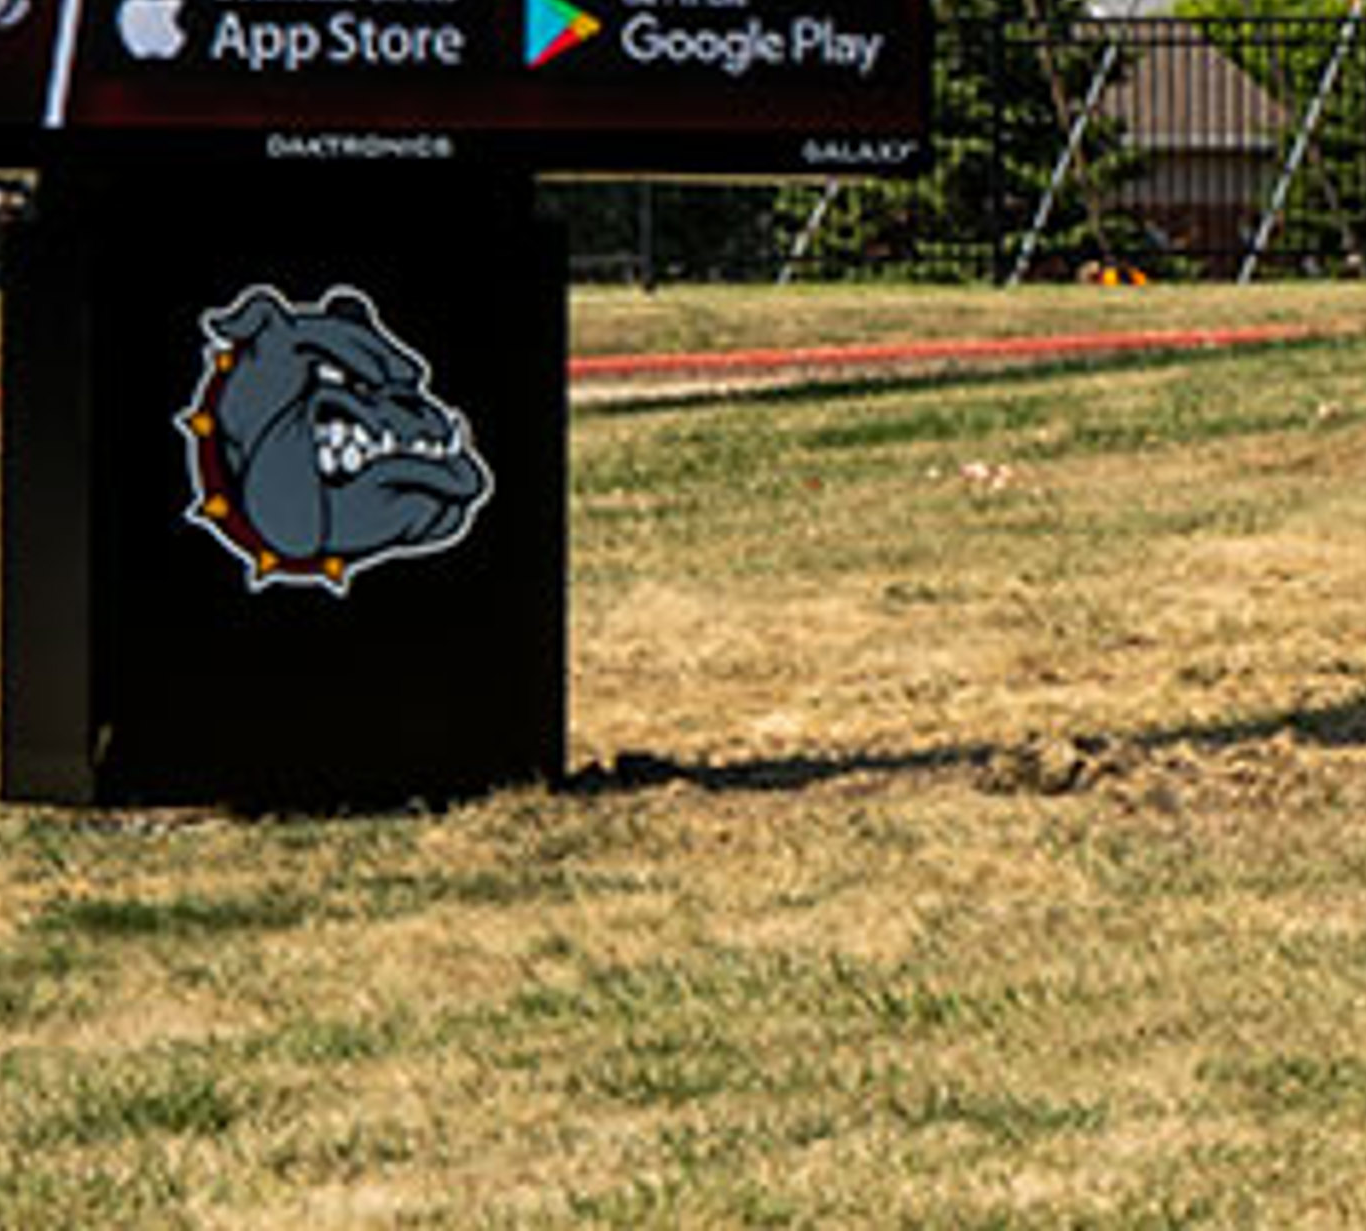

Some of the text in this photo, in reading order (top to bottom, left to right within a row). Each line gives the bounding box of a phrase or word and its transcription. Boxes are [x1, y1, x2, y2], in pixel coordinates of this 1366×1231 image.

[210, 9, 465, 72] App Store
[620, 11, 885, 78] Google Play
